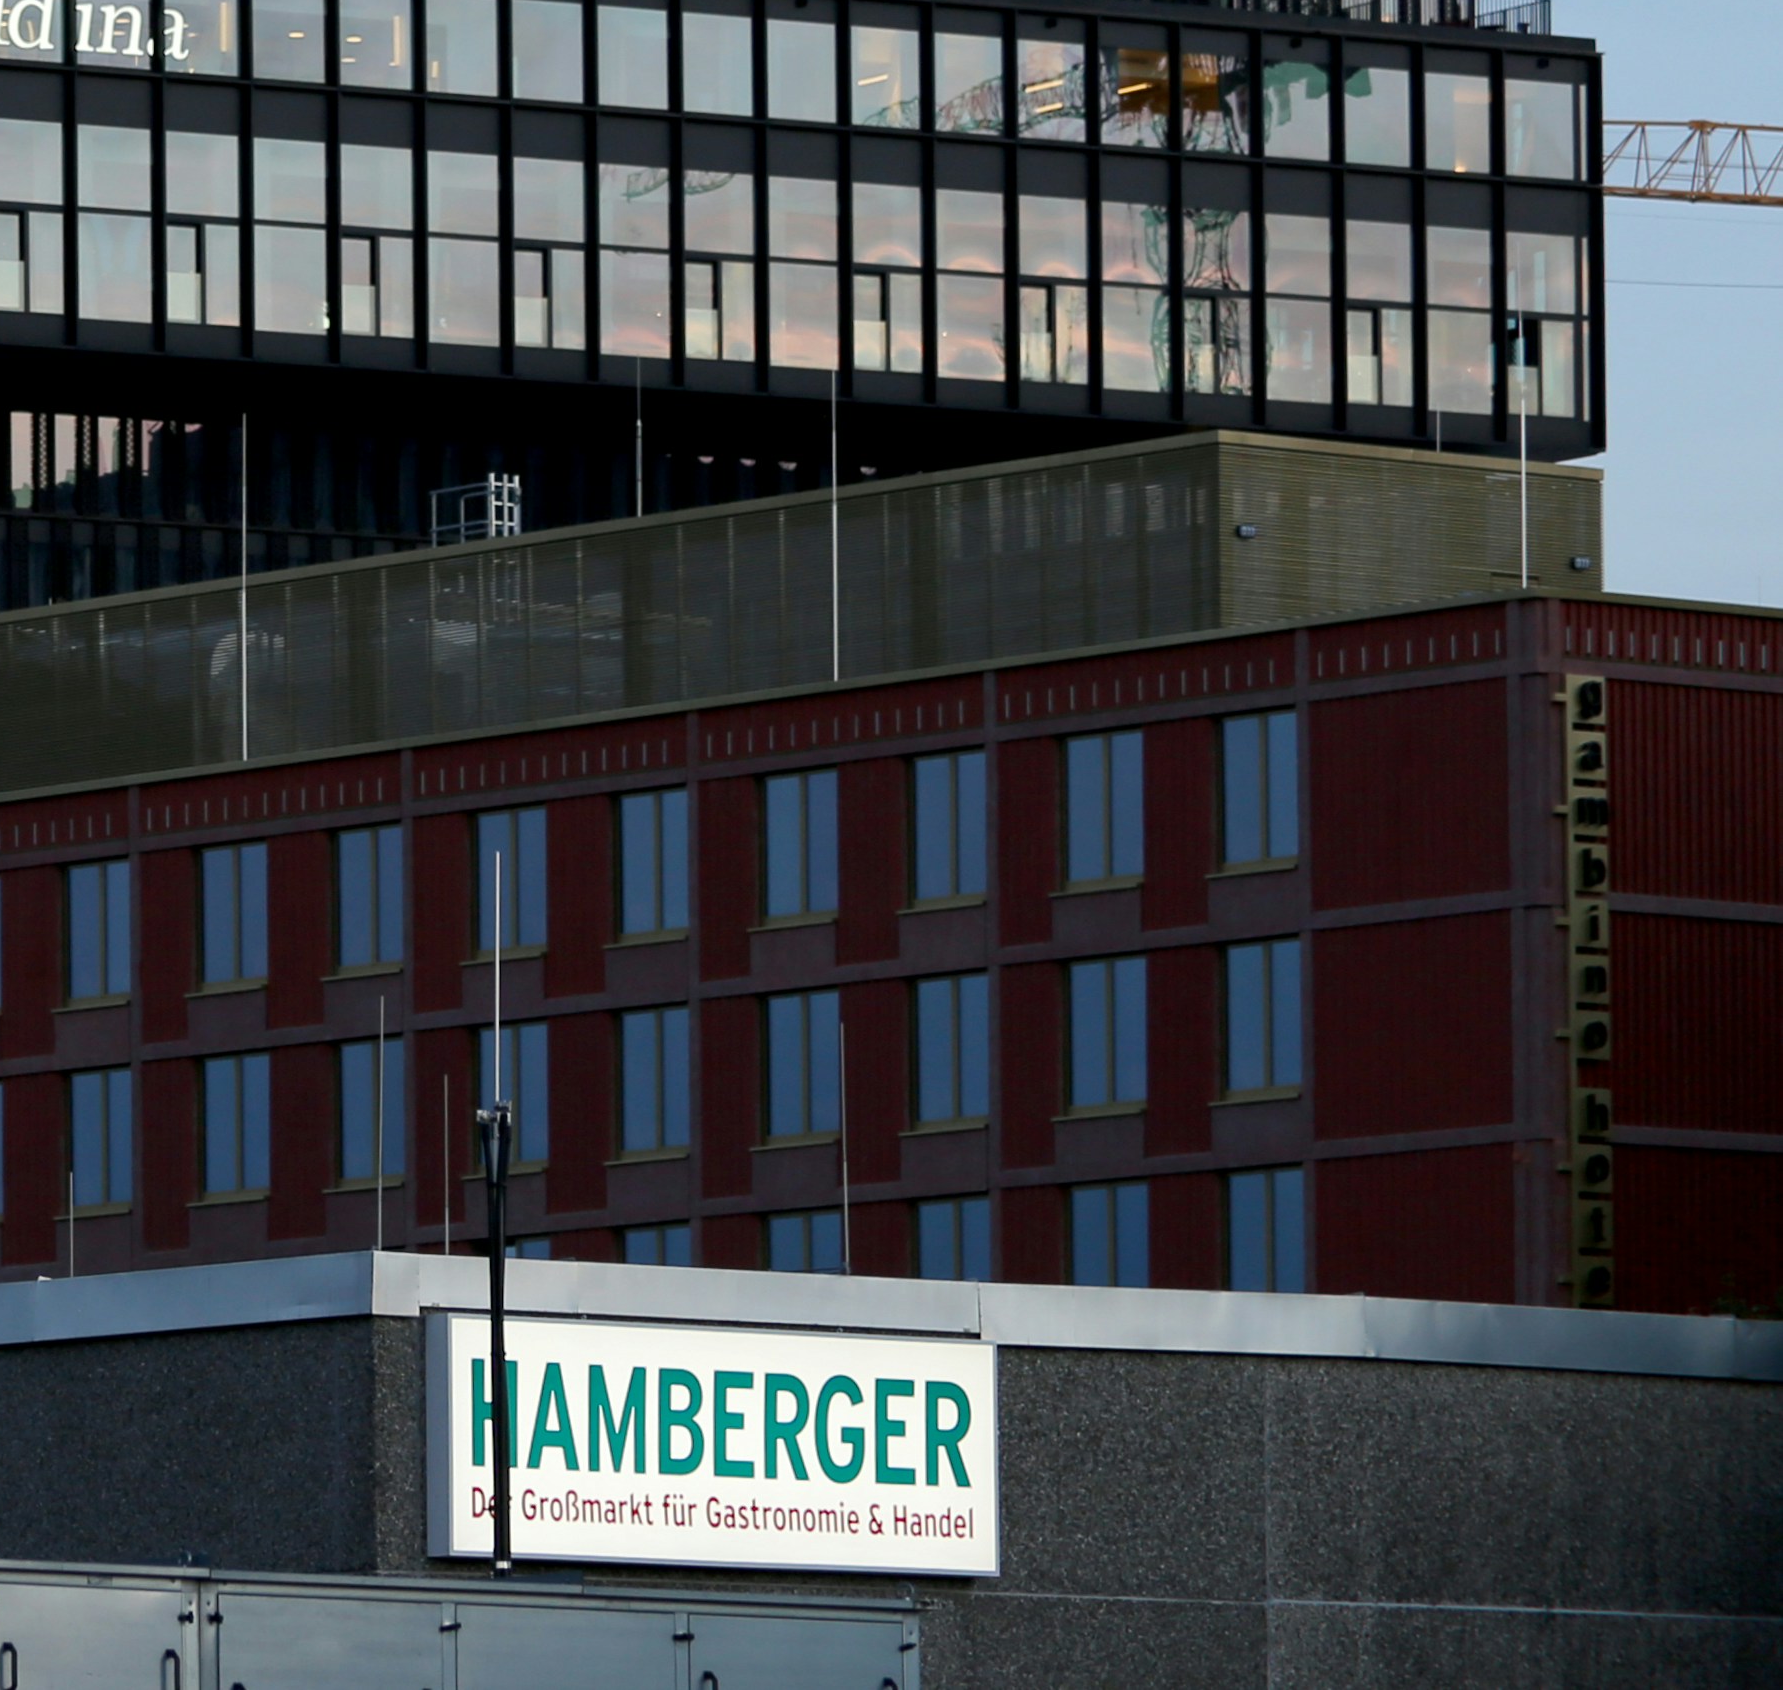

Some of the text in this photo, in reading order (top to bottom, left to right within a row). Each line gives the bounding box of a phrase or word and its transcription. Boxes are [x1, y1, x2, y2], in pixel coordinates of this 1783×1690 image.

[1575, 680, 1611, 1296] gambino hotel
[471, 1358, 972, 1488] HAMBERGER
[522, 1488, 654, 1526] Großmarkt
[663, 1494, 697, 1527] für
[706, 1496, 860, 1534] Gastronomie
[868, 1503, 884, 1535] &
[893, 1504, 974, 1539] Handel
